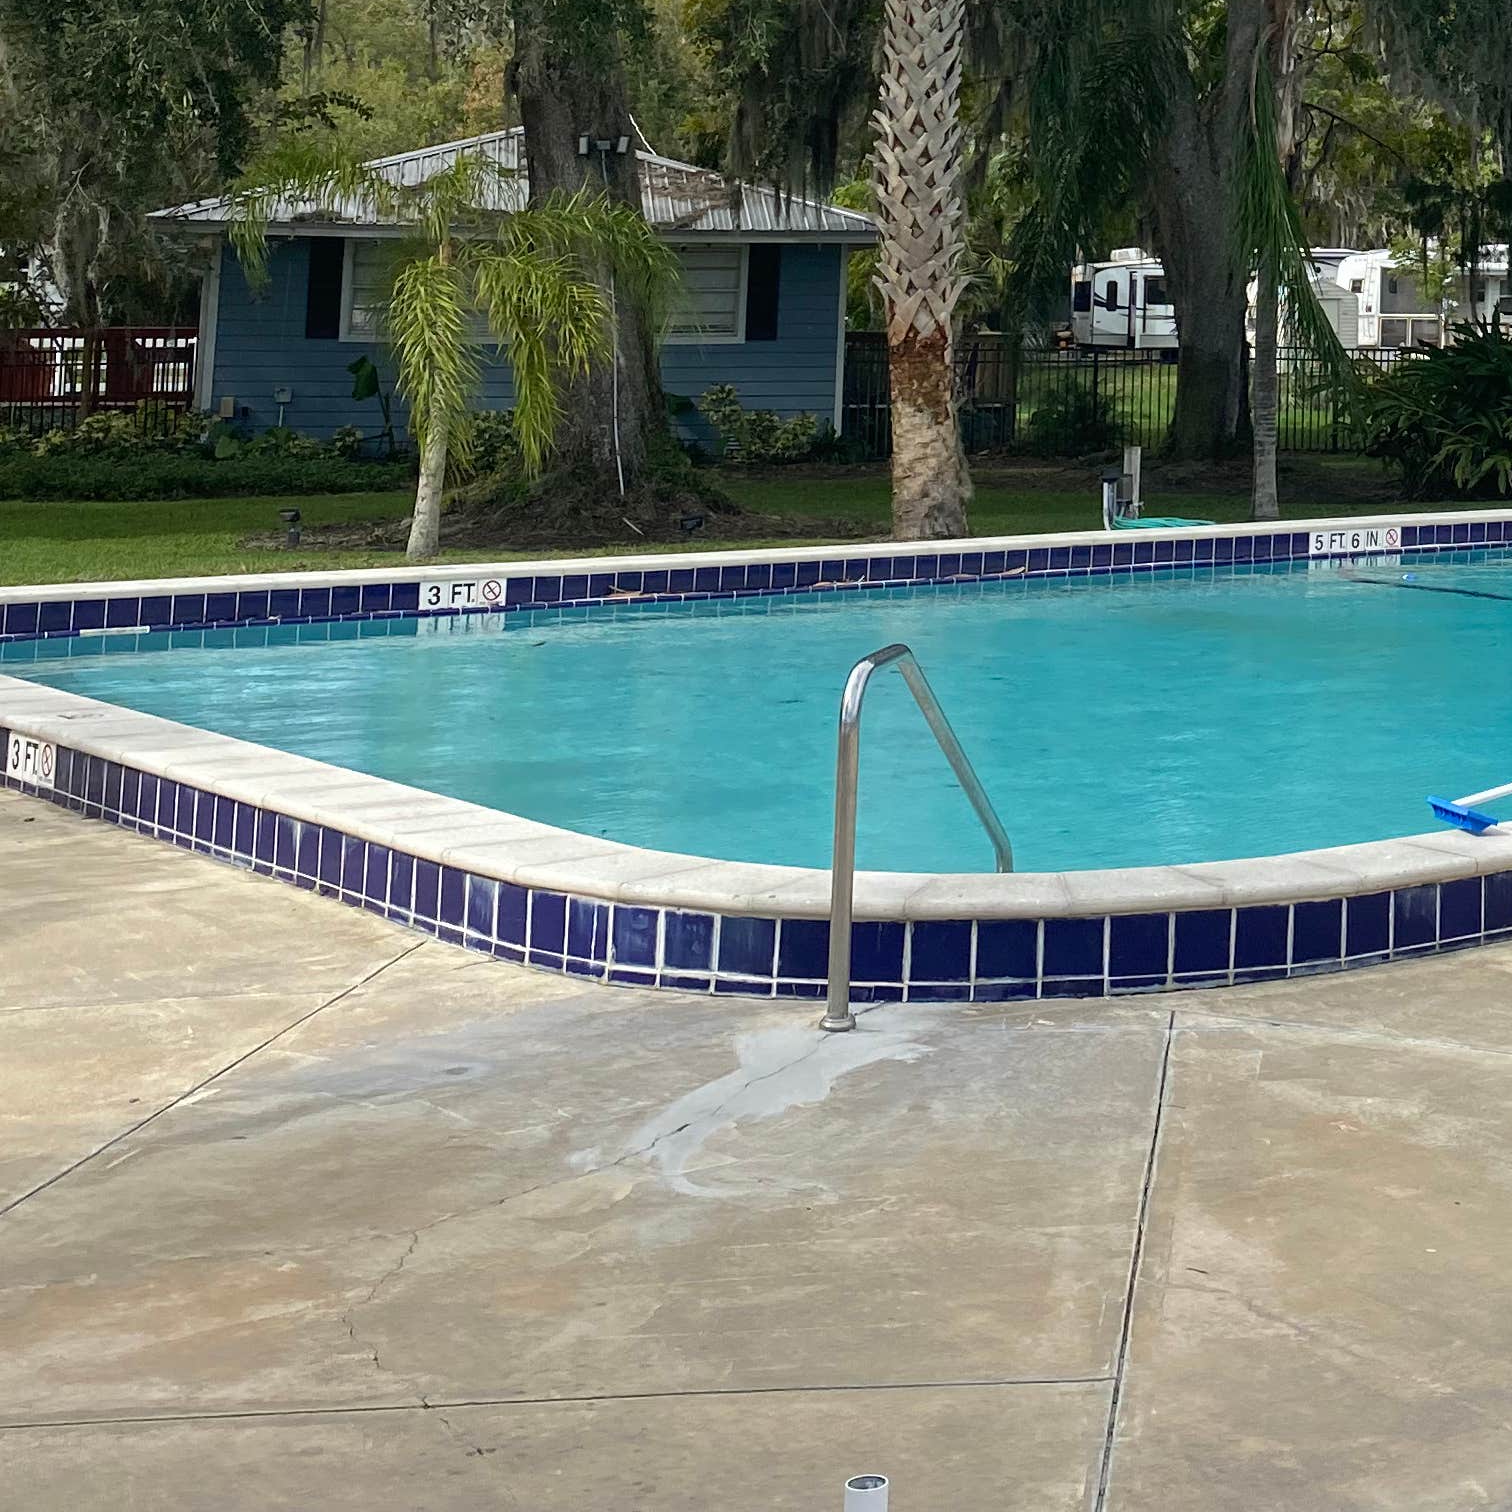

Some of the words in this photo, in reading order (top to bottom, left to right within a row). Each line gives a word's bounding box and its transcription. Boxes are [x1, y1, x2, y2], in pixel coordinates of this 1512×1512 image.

[1314, 534, 1324, 551] 5
[1351, 533, 1360, 549] 6
[428, 585, 441, 606] 3
[451, 583, 476, 604] FT.
[12, 738, 20, 770] 3
